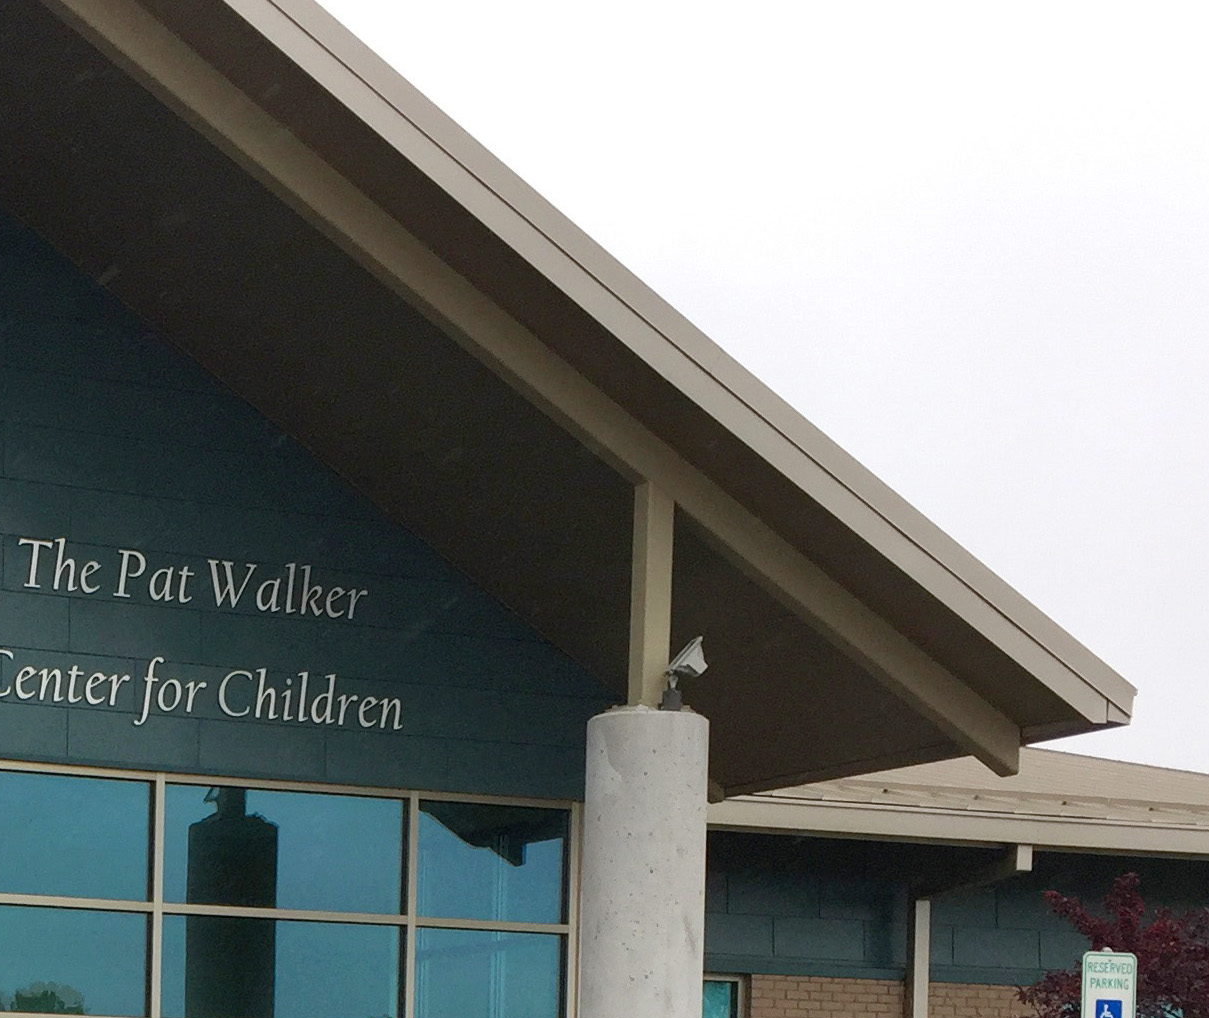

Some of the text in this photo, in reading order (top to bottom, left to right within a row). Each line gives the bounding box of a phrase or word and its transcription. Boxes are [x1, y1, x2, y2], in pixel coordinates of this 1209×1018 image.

[17, 538, 368, 620] The Pat Walker
[133, 656, 207, 726] for
[218, 668, 403, 730] Children
[1087, 961, 1133, 975] RESERVED
[1090, 977, 1130, 990] PARKING
